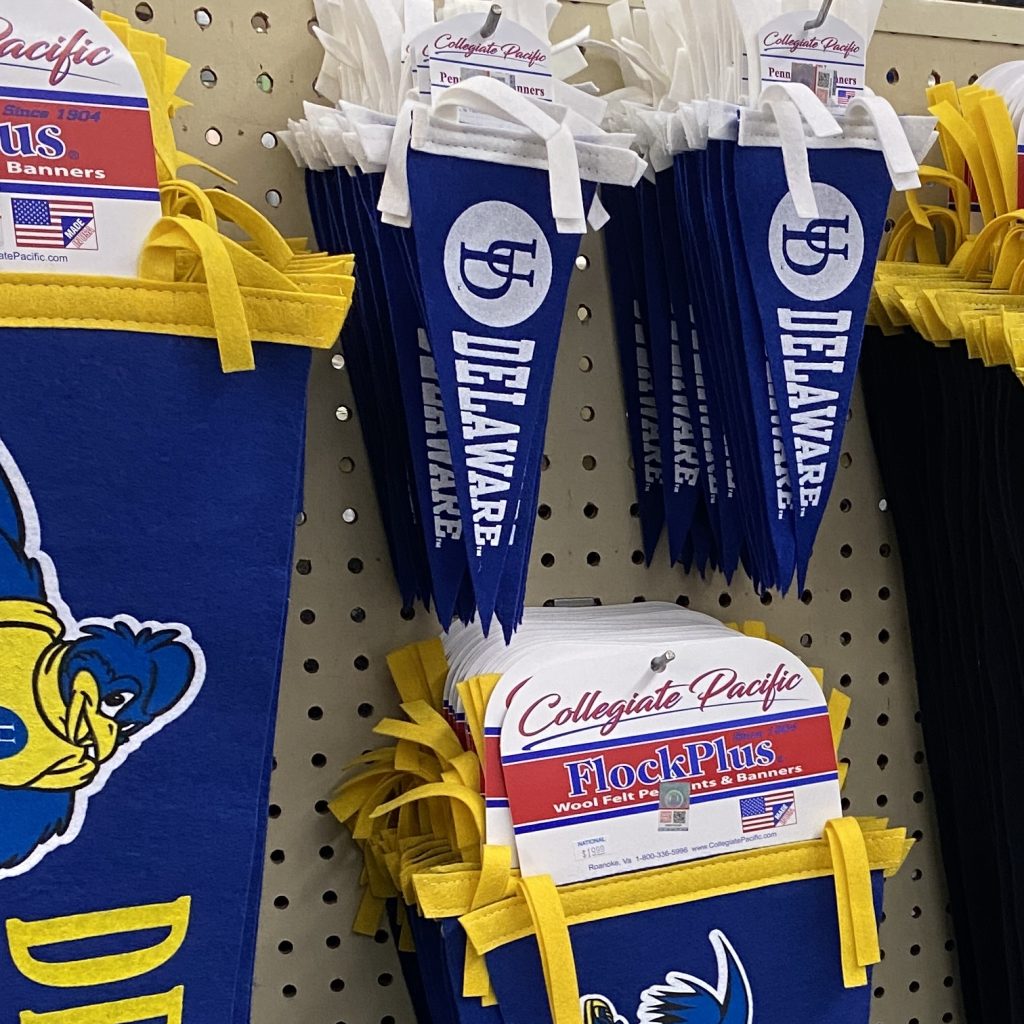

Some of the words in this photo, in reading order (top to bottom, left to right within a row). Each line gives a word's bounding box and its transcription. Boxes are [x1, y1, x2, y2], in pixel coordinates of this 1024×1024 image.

[434, 34, 498, 57] Collegiate
[500, 43, 547, 67] Pacific
[763, 31, 819, 53] Collegiate
[820, 37, 860, 59] Pacific
[2, 104, 49, 119] Since
[57, 108, 101, 122] 1904
[7, 161, 106, 179] Banners
[64, 217, 85, 240] MADE
[777, 307, 852, 507] DELAWARE
[452, 330, 536, 547] DELAWARE
[518, 680, 683, 737] Collegiate
[689, 662, 802, 712] Pacific
[563, 735, 776, 798] FlockPlus
[553, 797, 599, 813] Wool
[602, 792, 635, 805] Felt
[720, 775, 733, 785] &
[736, 765, 803, 783] Banners
[577, 836, 605, 847] NATIONAL
[692, 831, 778, 851] www.CollegiatePacific.com
